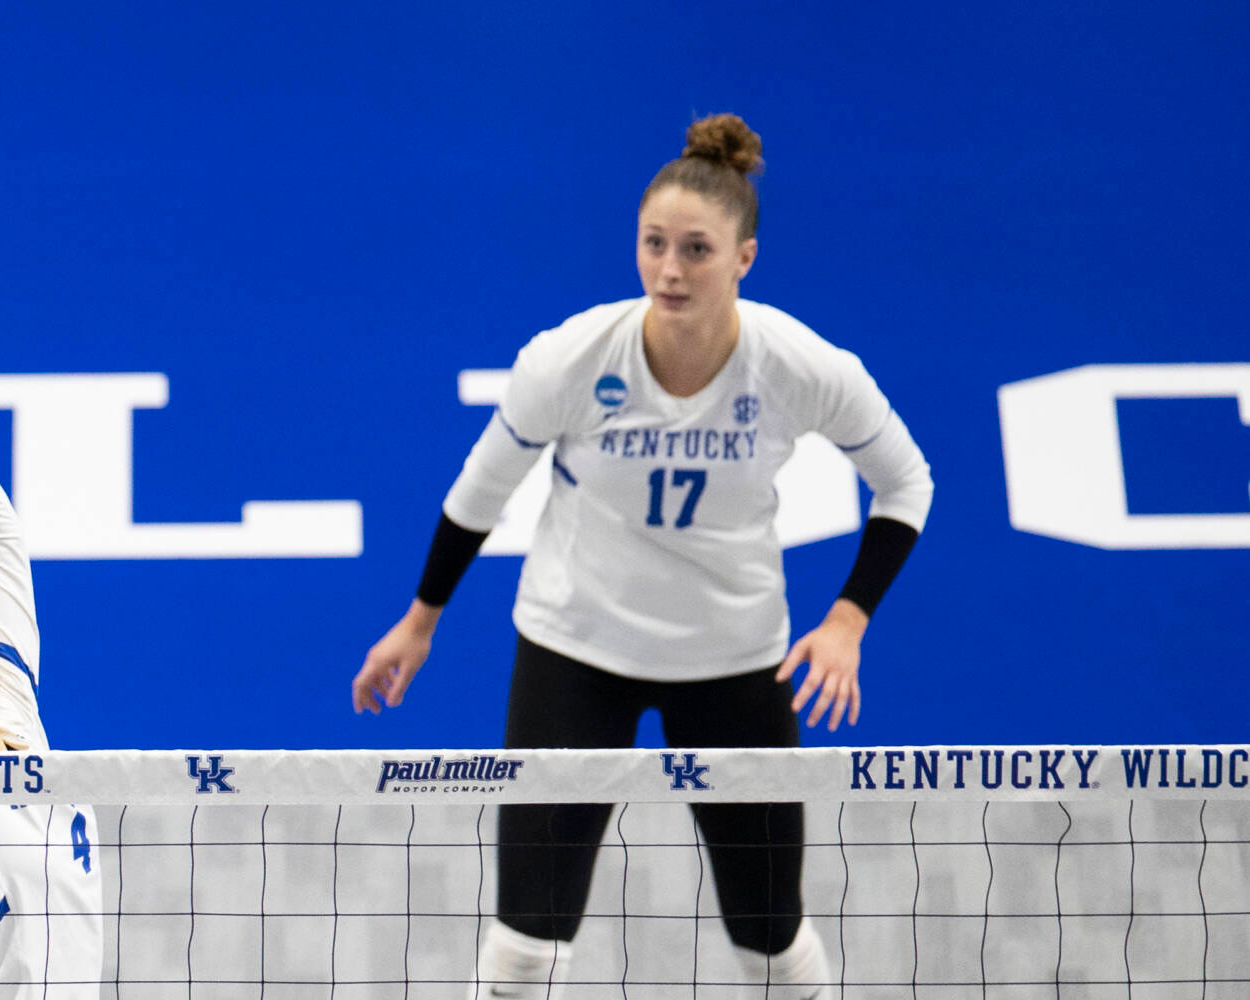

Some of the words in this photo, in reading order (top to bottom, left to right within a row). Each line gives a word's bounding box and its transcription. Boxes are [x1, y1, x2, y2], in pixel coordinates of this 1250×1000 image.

[601, 428, 759, 461] KENTUCKY
[646, 467, 708, 529] 17
[185, 754, 235, 793] UK
[376, 755, 443, 793] paul
[443, 755, 524, 781] miller
[660, 752, 710, 790] UK
[851, 750, 1098, 789] KENTUCKY
[1121, 749, 1249, 788] WILDC
[71, 811, 91, 874] 4
